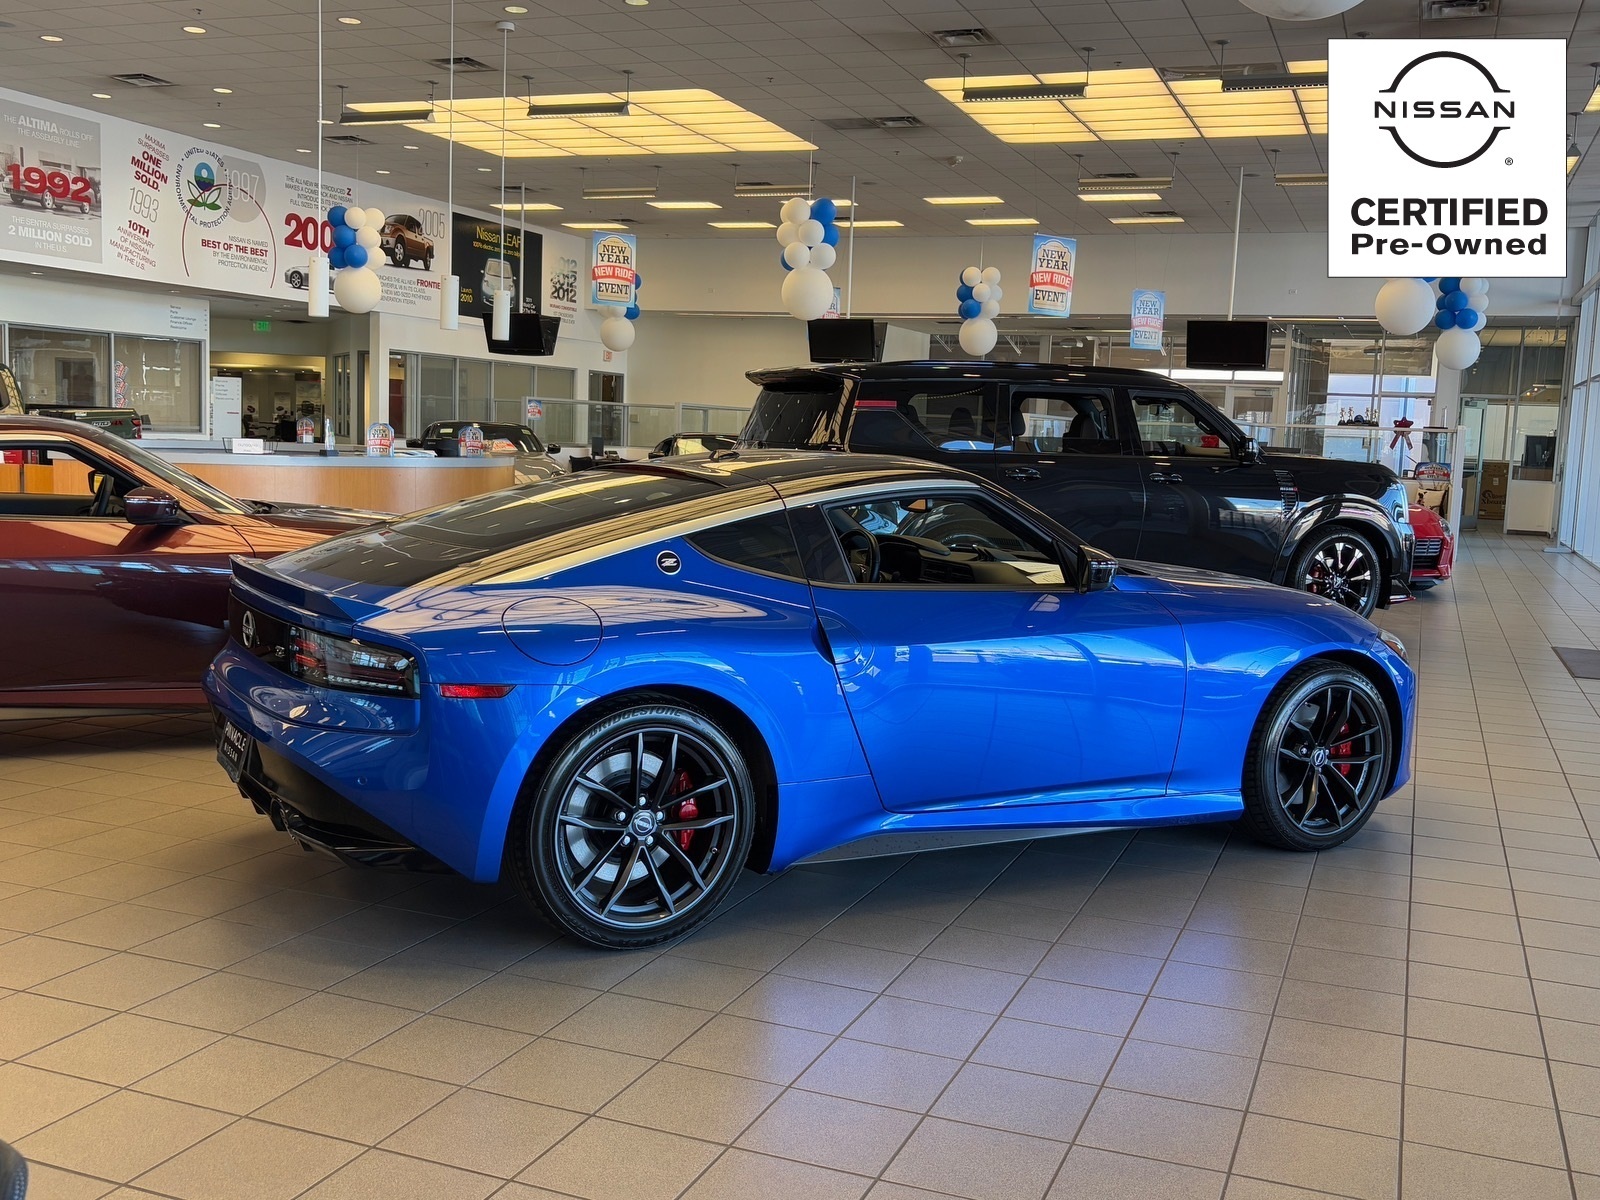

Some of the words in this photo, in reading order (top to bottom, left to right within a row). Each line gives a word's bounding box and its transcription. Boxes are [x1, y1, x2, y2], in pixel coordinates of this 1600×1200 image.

[4, 115, 16, 124] THE
[18, 115, 58, 133] ALTIMA
[60, 128, 80, 139] ROLLS
[81, 133, 94, 141] OFF
[18, 128, 30, 136] THE
[32, 131, 64, 144] ASSEMBLY
[66, 139, 80, 148] LINE
[145, 134, 165, 150] MAXIMA
[138, 138, 169, 161] SURPASSES
[142, 151, 162, 169] ONE
[131, 156, 168, 184] MILLION
[8, 163, 92, 204] 1992
[134, 170, 160, 192] SOLD.
[225, 169, 259, 202] 1997
[298, 193, 324, 204] INTRODUCS
[346, 188, 352, 196] Z
[129, 187, 159, 222] 1993
[12, 216, 25, 224] THE
[26, 218, 51, 229] SENTRA
[52, 222, 89, 235] SURPASSES
[200, 206, 230, 228] PROTECTION
[418, 208, 445, 239] 2005
[8, 225, 15, 235] 2
[18, 226, 62, 242] MILLION
[65, 234, 92, 247] SOLD
[118, 226, 154, 248] ANNIVERSARY
[128, 220, 149, 238] 10TH
[285, 213, 335, 254] 200
[477, 226, 500, 244] Nissan
[44, 243, 55, 251] THE
[129, 240, 149, 254] NISSAN
[202, 239, 221, 249] BEST
[223, 243, 233, 251] OF
[235, 245, 248, 254] THE
[250, 247, 268, 257] BEST
[229, 235, 246, 244] NISSAN
[110, 240, 156, 267] MANUFACTURING
[599, 253, 630, 264] YEAR
[602, 244, 627, 255] NEW
[1042, 249, 1066, 260] NEW
[124, 255, 135, 265] THE
[218, 260, 248, 270] PROTECTION
[231, 254, 268, 265] ENVIRONMENTAL
[1038, 258, 1068, 271] YEAR
[594, 266, 614, 277] NEW
[615, 267, 633, 280] RIDE
[1033, 272, 1051, 283] NEW
[1053, 273, 1071, 287] RIDE
[417, 279, 441, 290] FRONTIE
[598, 282, 630, 295] EVENT
[460, 294, 473, 303] 2010
[550, 285, 576, 303] 2012
[1035, 289, 1066, 303] EVENT
[1136, 307, 1159, 315] YEAR
[1133, 317, 1146, 326] NEW
[1147, 318, 1162, 328] RIDE
[1135, 330, 1158, 340] EVENT
[588, 706, 681, 738] BRIDGESTONE
[225, 722, 246, 751] PINNACLE
[224, 742, 238, 762] NISSAN
